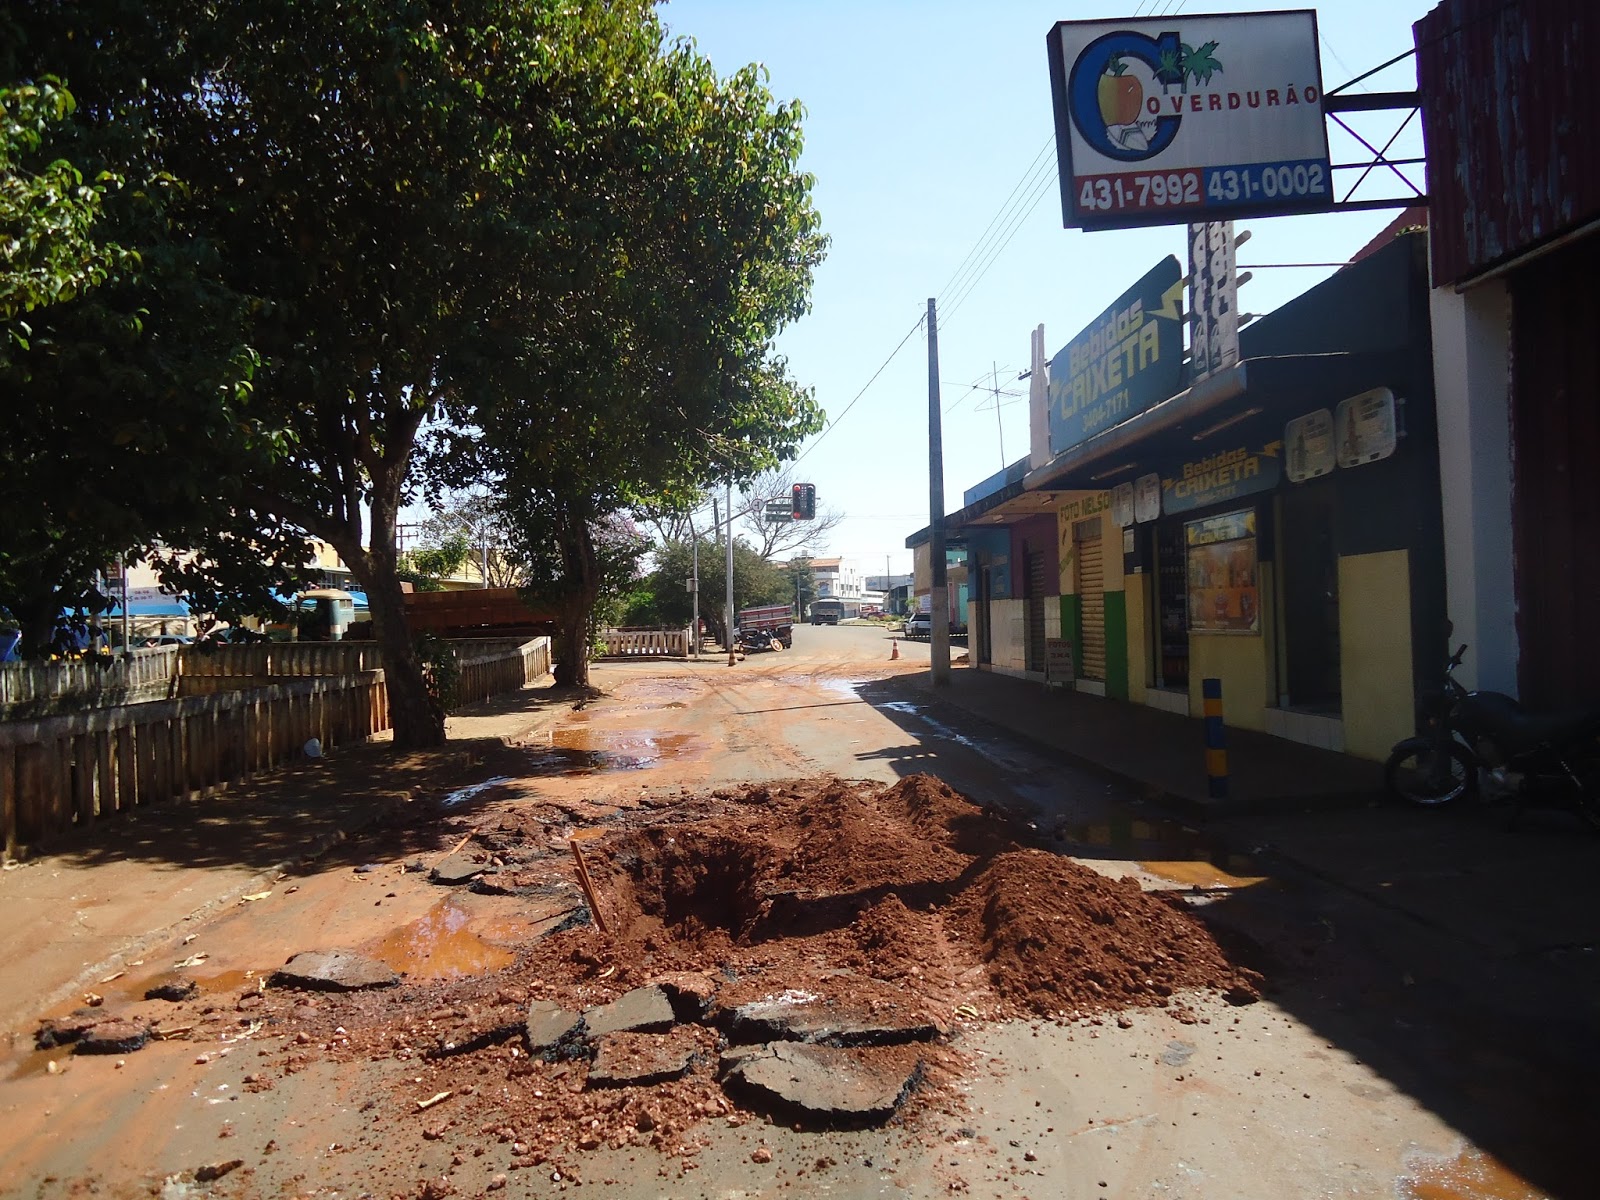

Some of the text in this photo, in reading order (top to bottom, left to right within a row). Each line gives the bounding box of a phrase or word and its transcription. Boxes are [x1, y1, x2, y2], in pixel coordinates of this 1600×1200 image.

[1146, 83, 1319, 115] O VERDURÃO
[1079, 172, 1201, 211] 431-7992
[1208, 163, 1326, 201] 431-0002
[1069, 298, 1144, 378] Bebidas
[1060, 319, 1160, 420] CAIXETA
[1175, 456, 1261, 498] CAIXETA
[1183, 446, 1248, 480] Bebidas
[1060, 491, 1113, 523] FOTO NELSO
